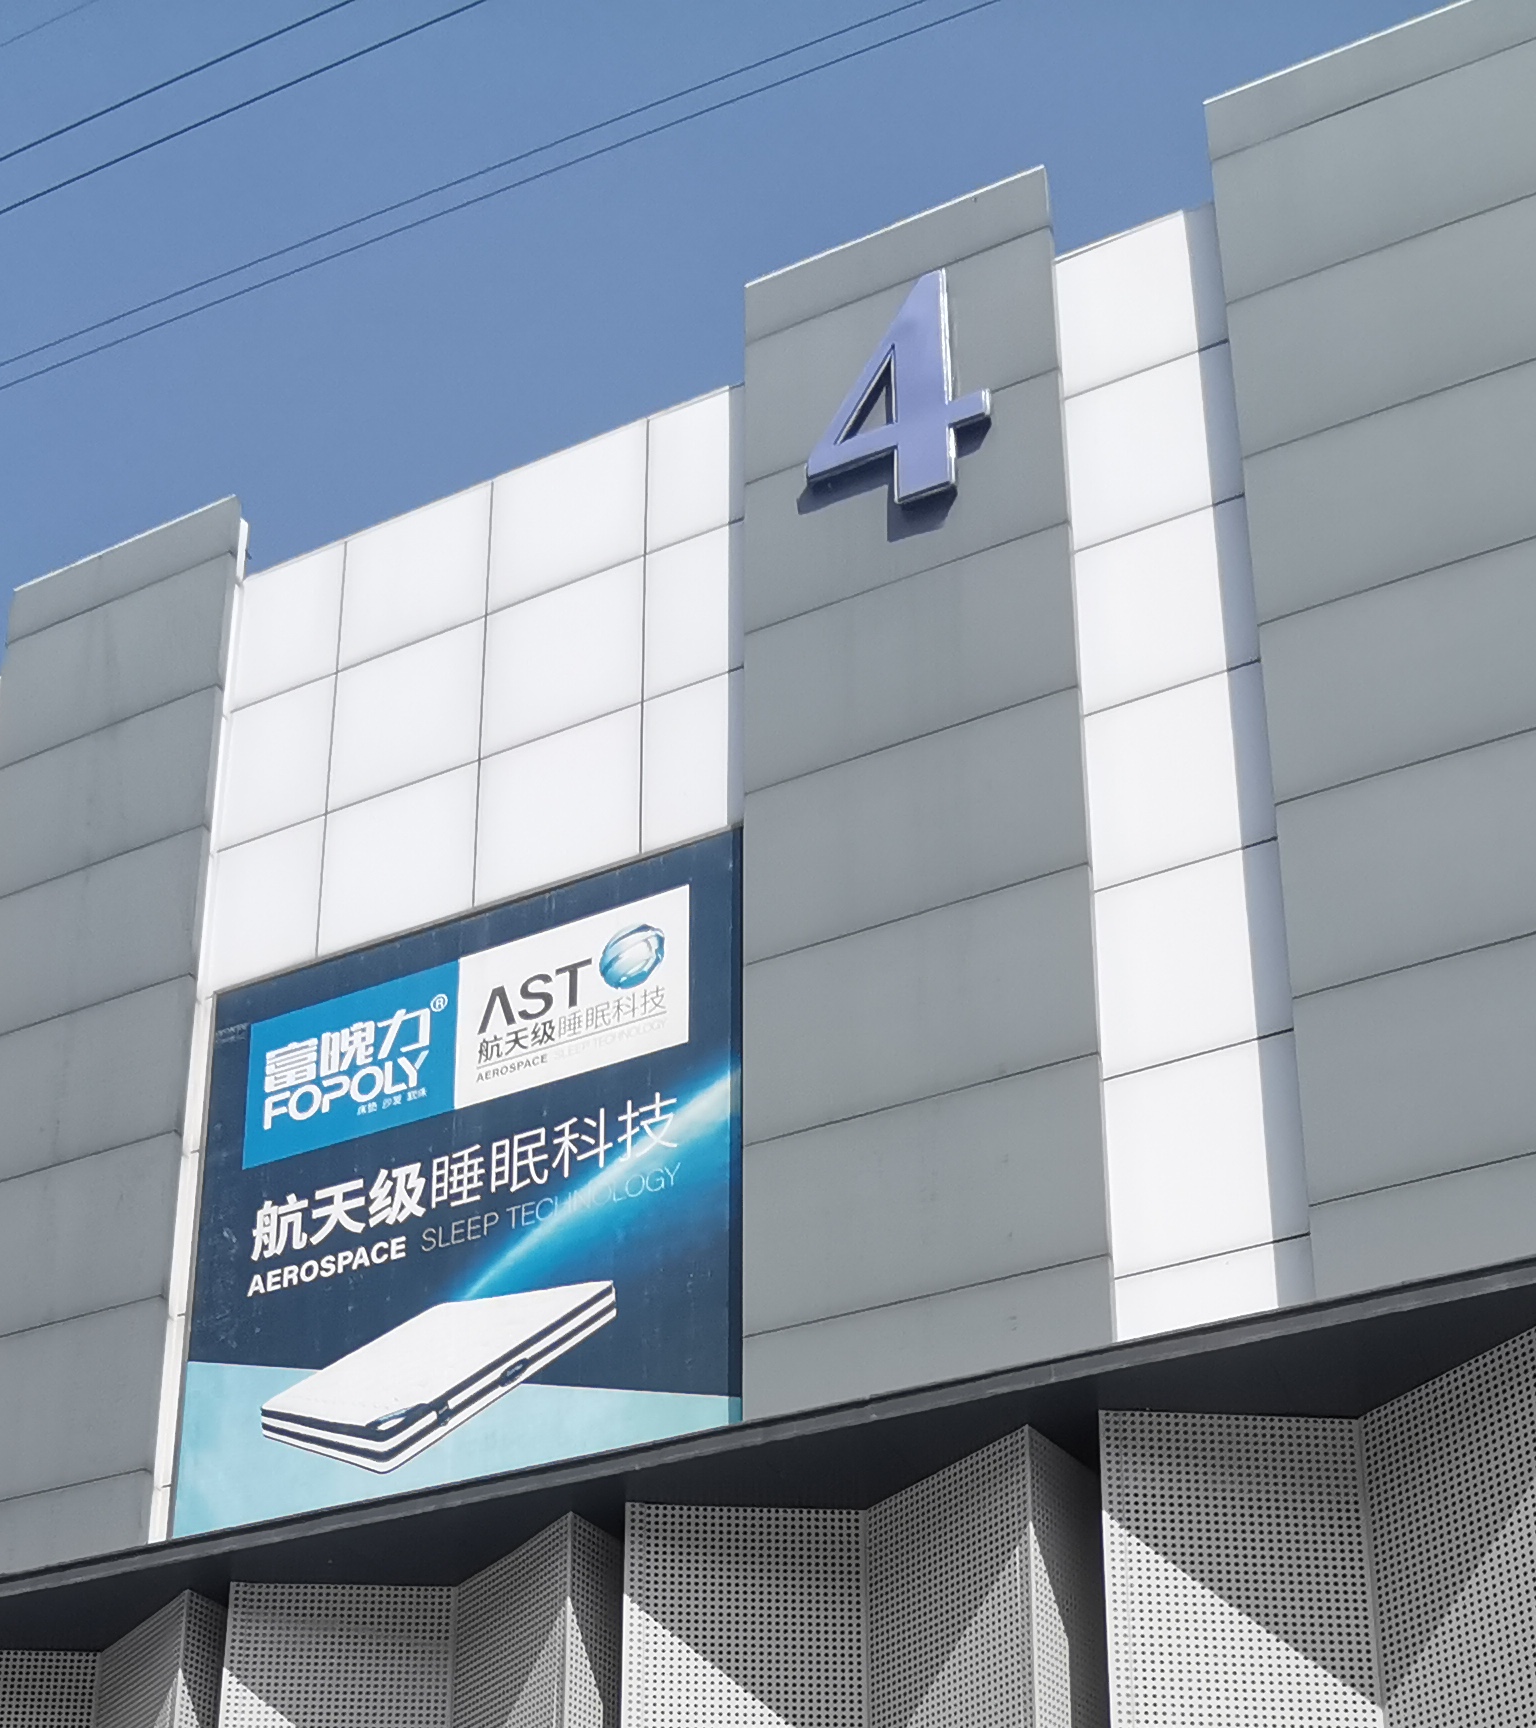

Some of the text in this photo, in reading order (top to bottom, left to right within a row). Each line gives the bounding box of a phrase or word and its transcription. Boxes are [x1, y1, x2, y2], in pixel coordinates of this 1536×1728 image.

[805, 267, 991, 504] 4
[476, 1055, 548, 1083] AEROSPACE
[477, 985, 667, 1064] 航天级睡眠科技
[263, 1050, 430, 1130] FOPOLY
[246, 1162, 682, 1298] AEROSPACE SLEEP TECHNOLOGY
[250, 1092, 680, 1261] 航天级睡眠科技
